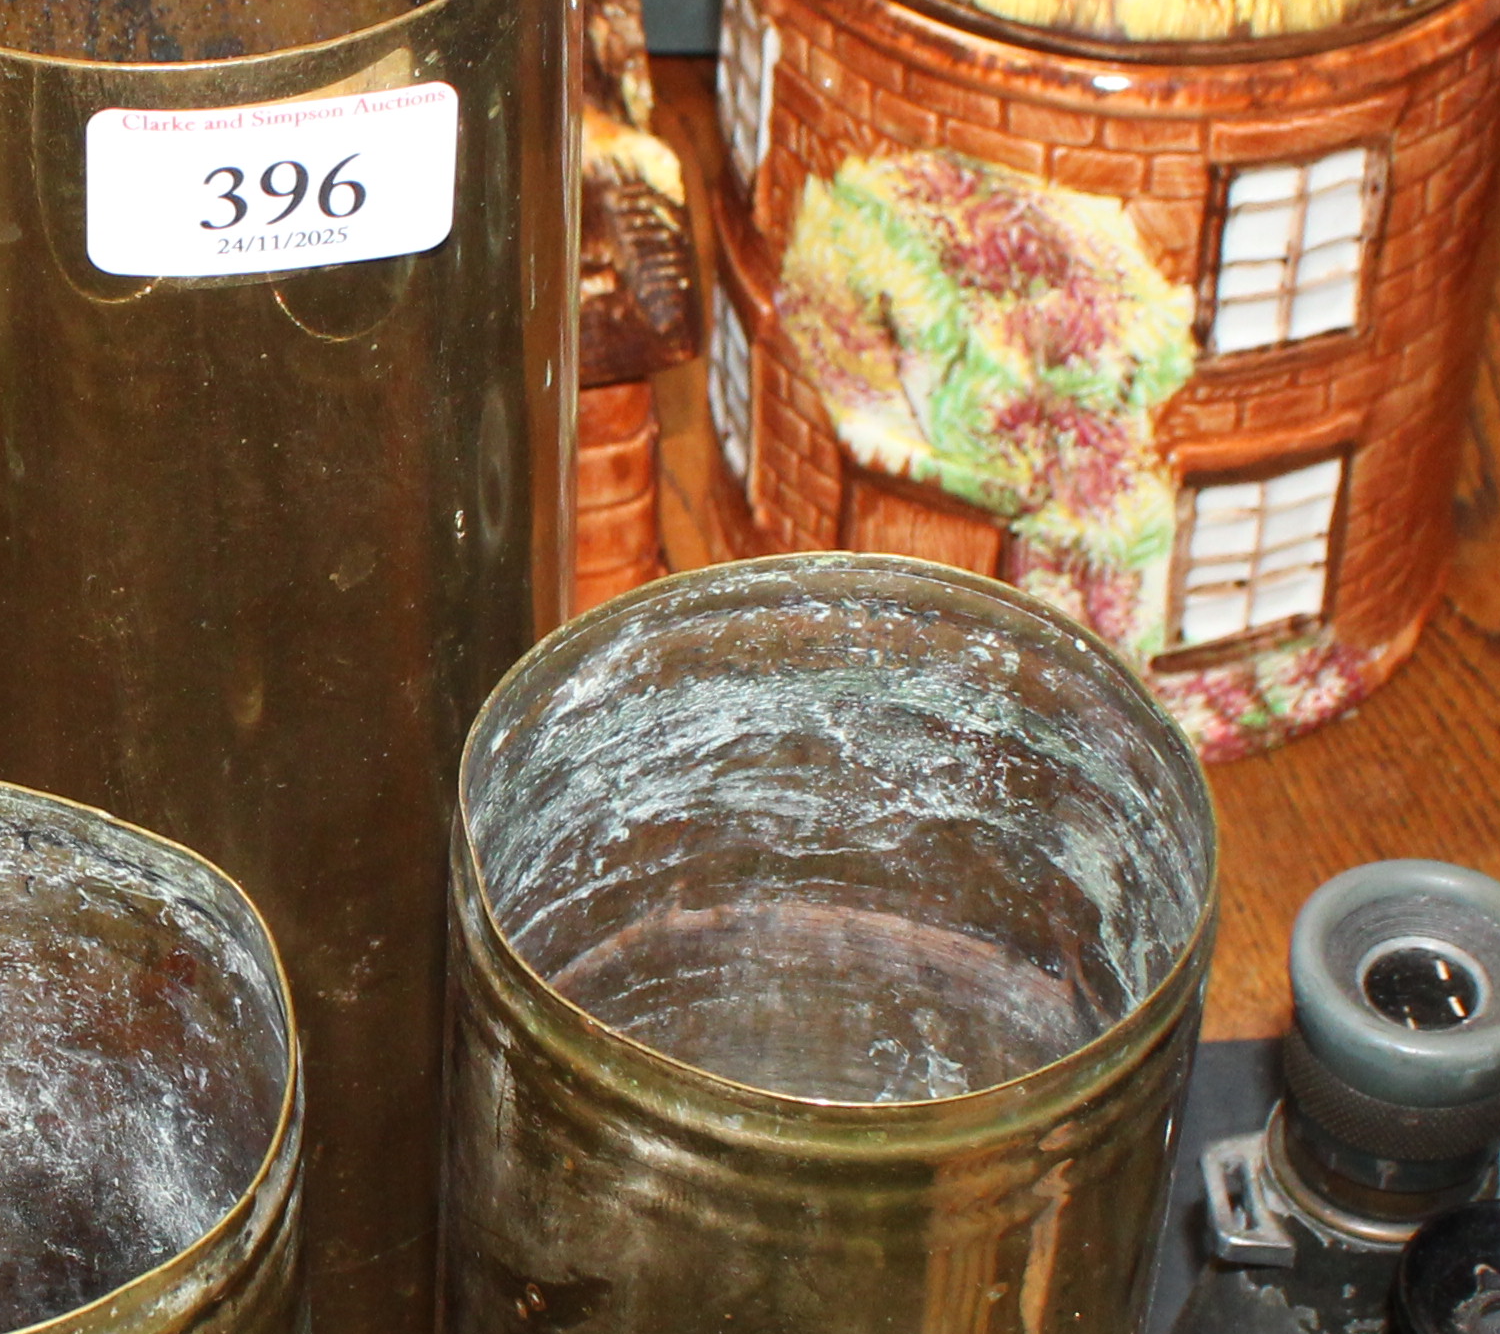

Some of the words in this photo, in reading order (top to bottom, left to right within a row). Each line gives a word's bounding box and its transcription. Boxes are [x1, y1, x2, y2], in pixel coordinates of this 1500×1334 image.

[121, 114, 196, 132] Clarke
[203, 113, 243, 130] and
[250, 107, 344, 129] Simpson
[352, 89, 447, 116] Auctions
[199, 152, 367, 230] 396
[216, 225, 349, 255] 24/11/2025
